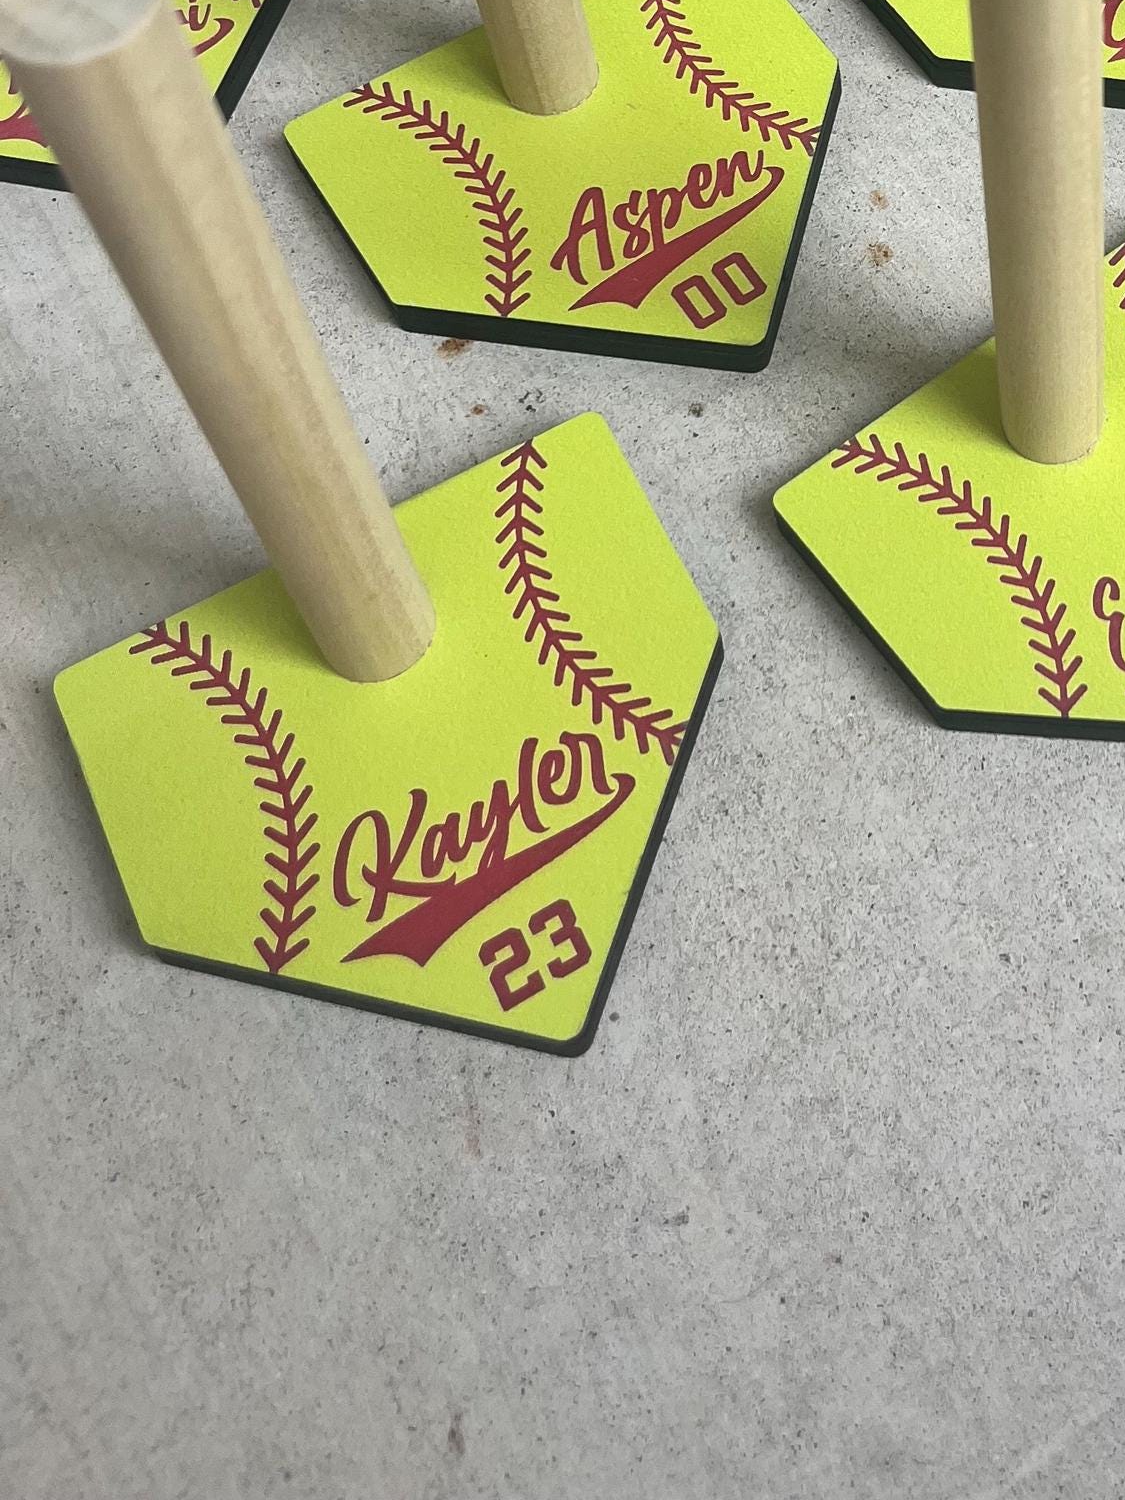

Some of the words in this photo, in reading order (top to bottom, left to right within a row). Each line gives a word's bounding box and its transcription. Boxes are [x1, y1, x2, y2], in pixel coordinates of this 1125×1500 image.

[550, 149, 764, 286] Aspen
[671, 252, 768, 330] 00
[332, 730, 615, 923] Kayler
[478, 898, 593, 1012] 23
